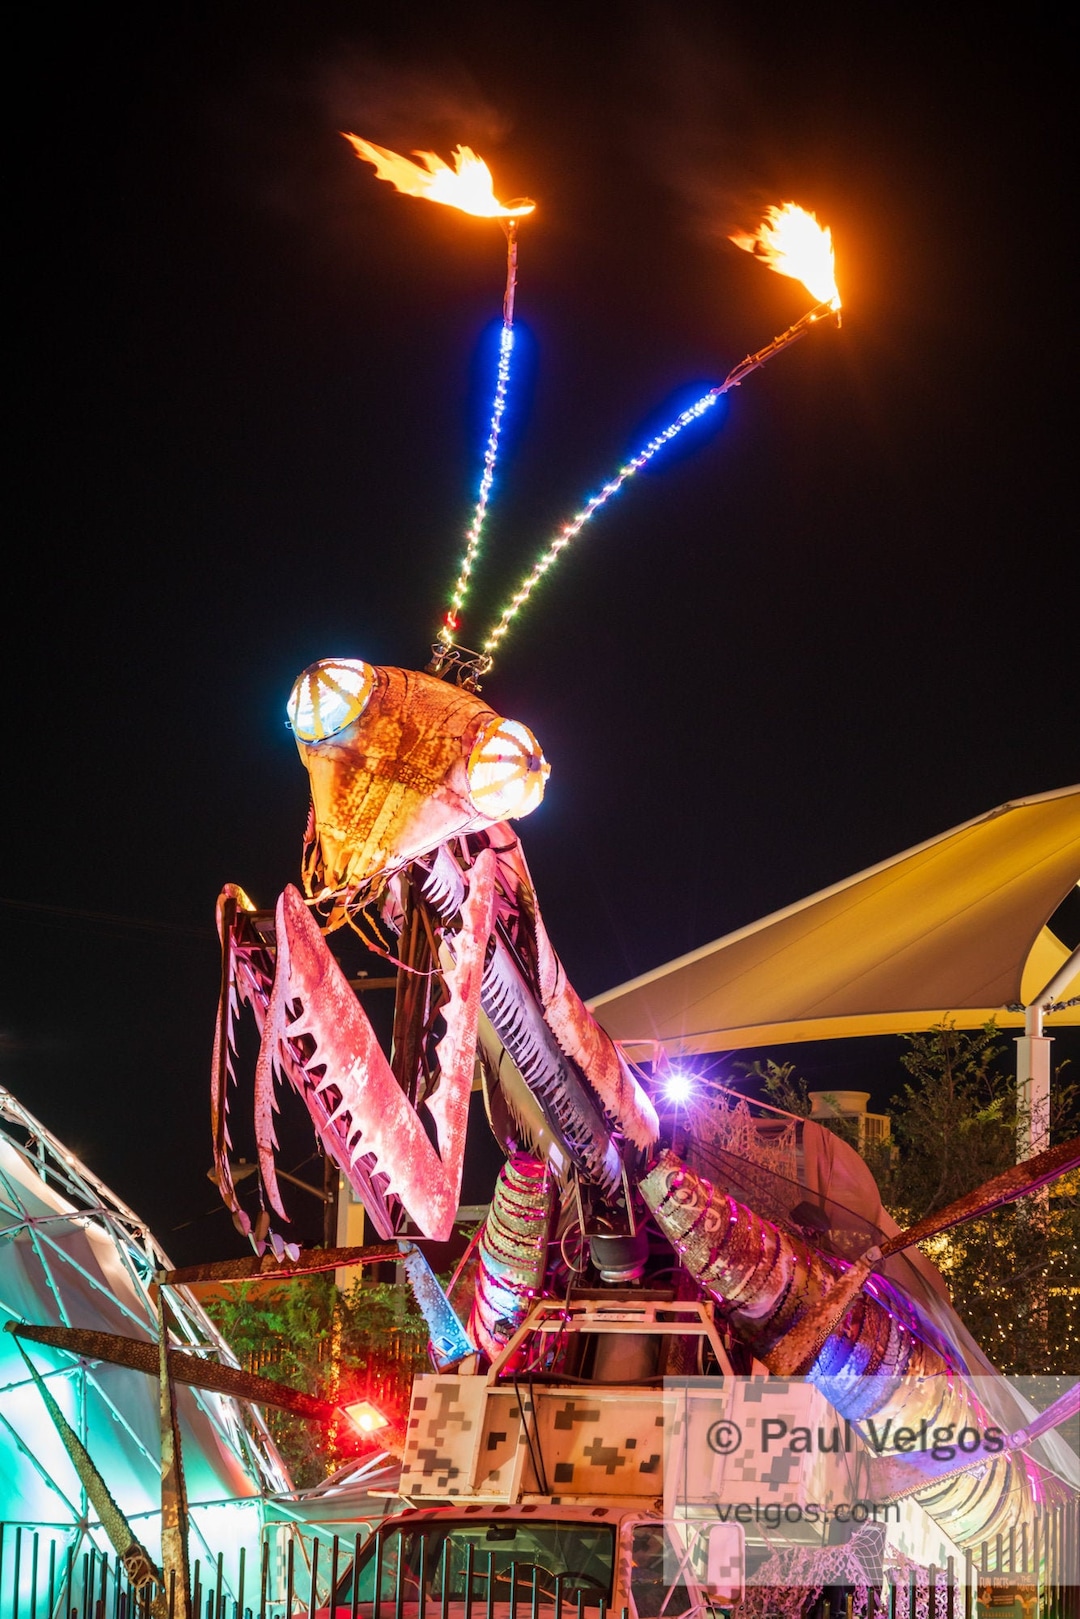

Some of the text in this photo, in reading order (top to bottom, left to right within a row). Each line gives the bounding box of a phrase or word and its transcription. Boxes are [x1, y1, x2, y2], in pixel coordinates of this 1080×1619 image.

[980, 1576, 1009, 1589] FUN FACTS
[1021, 1575, 1032, 1583] THE
